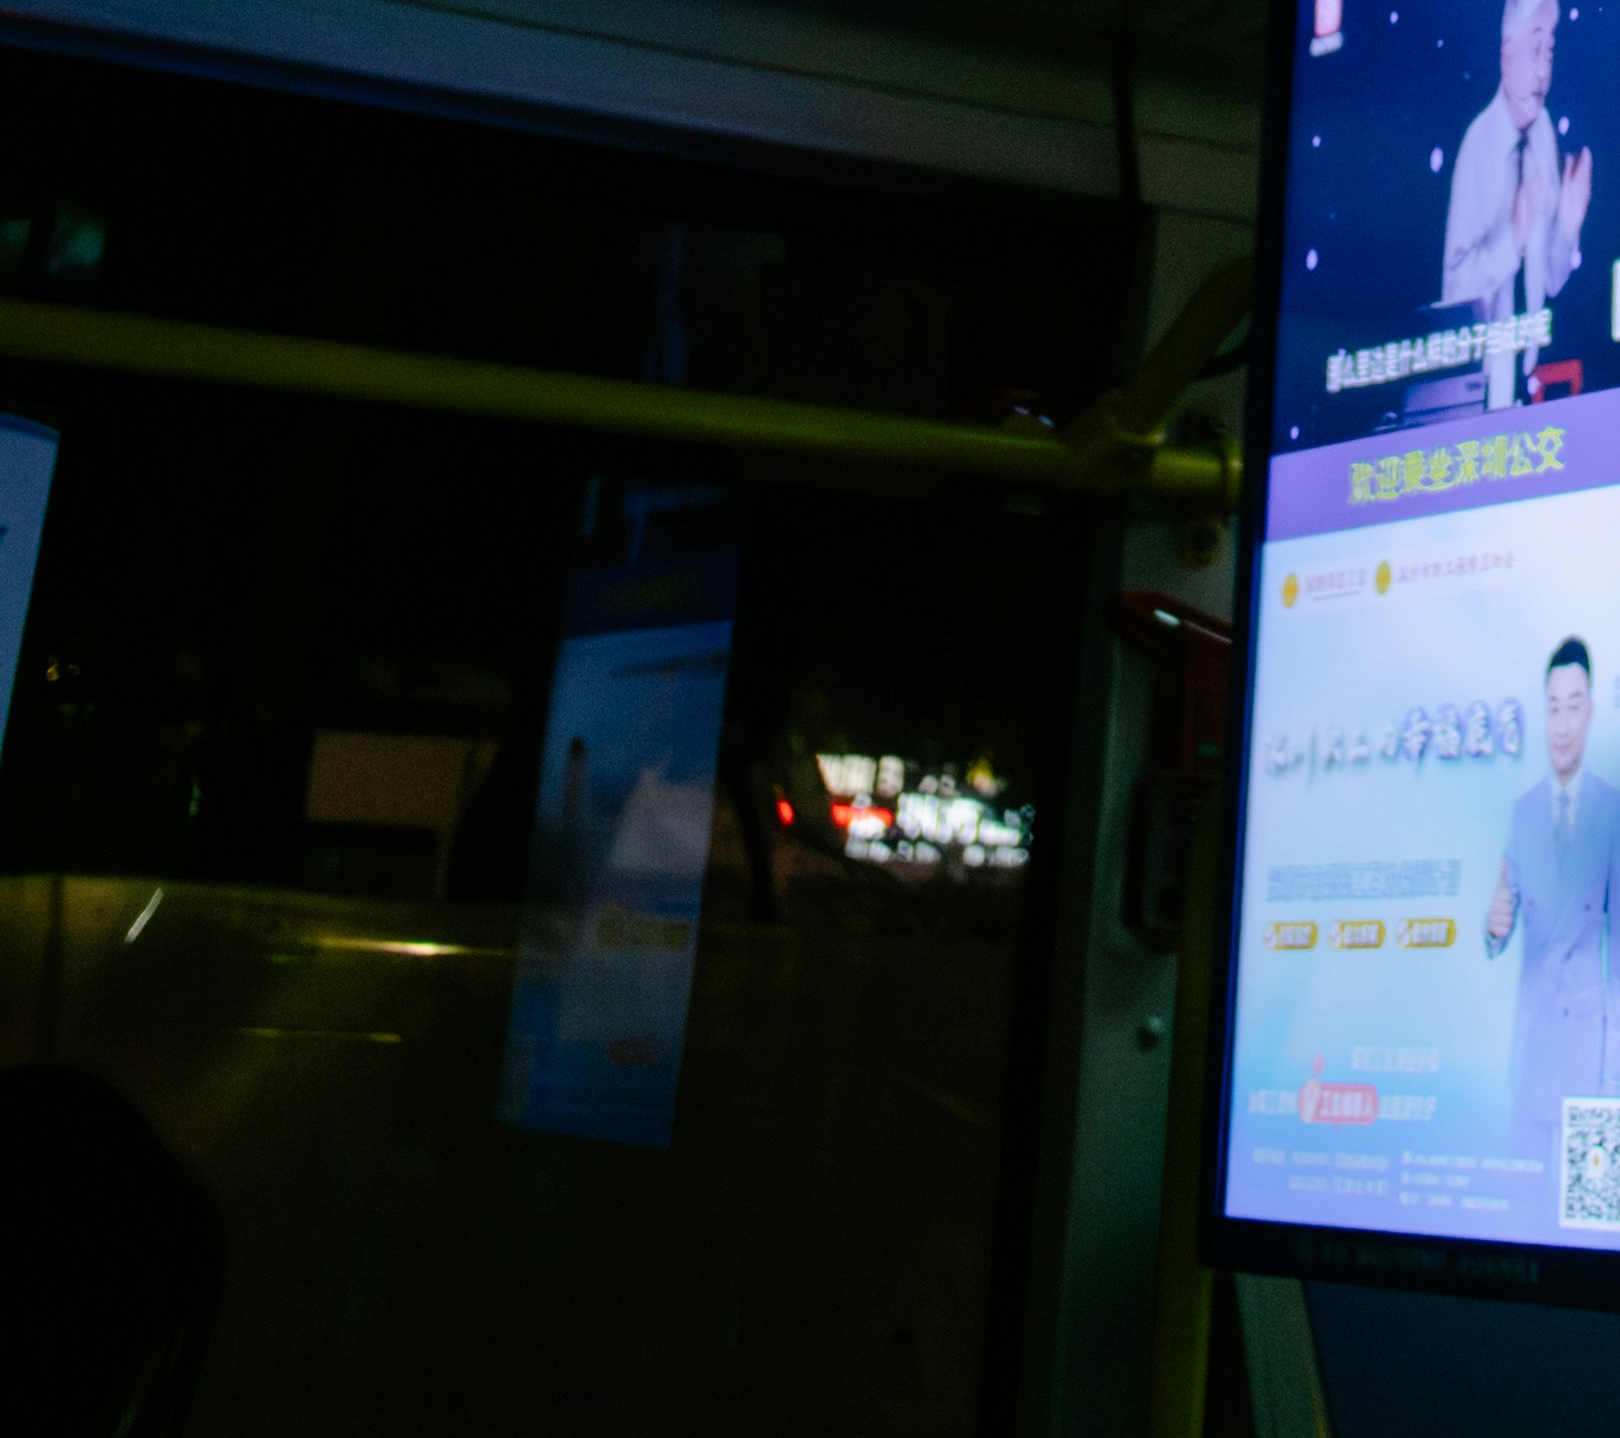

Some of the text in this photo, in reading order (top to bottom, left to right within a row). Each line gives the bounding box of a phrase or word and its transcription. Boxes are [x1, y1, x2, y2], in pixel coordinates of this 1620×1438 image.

[1350, 426, 1566, 503] 欢迎乘坐深圳公交
